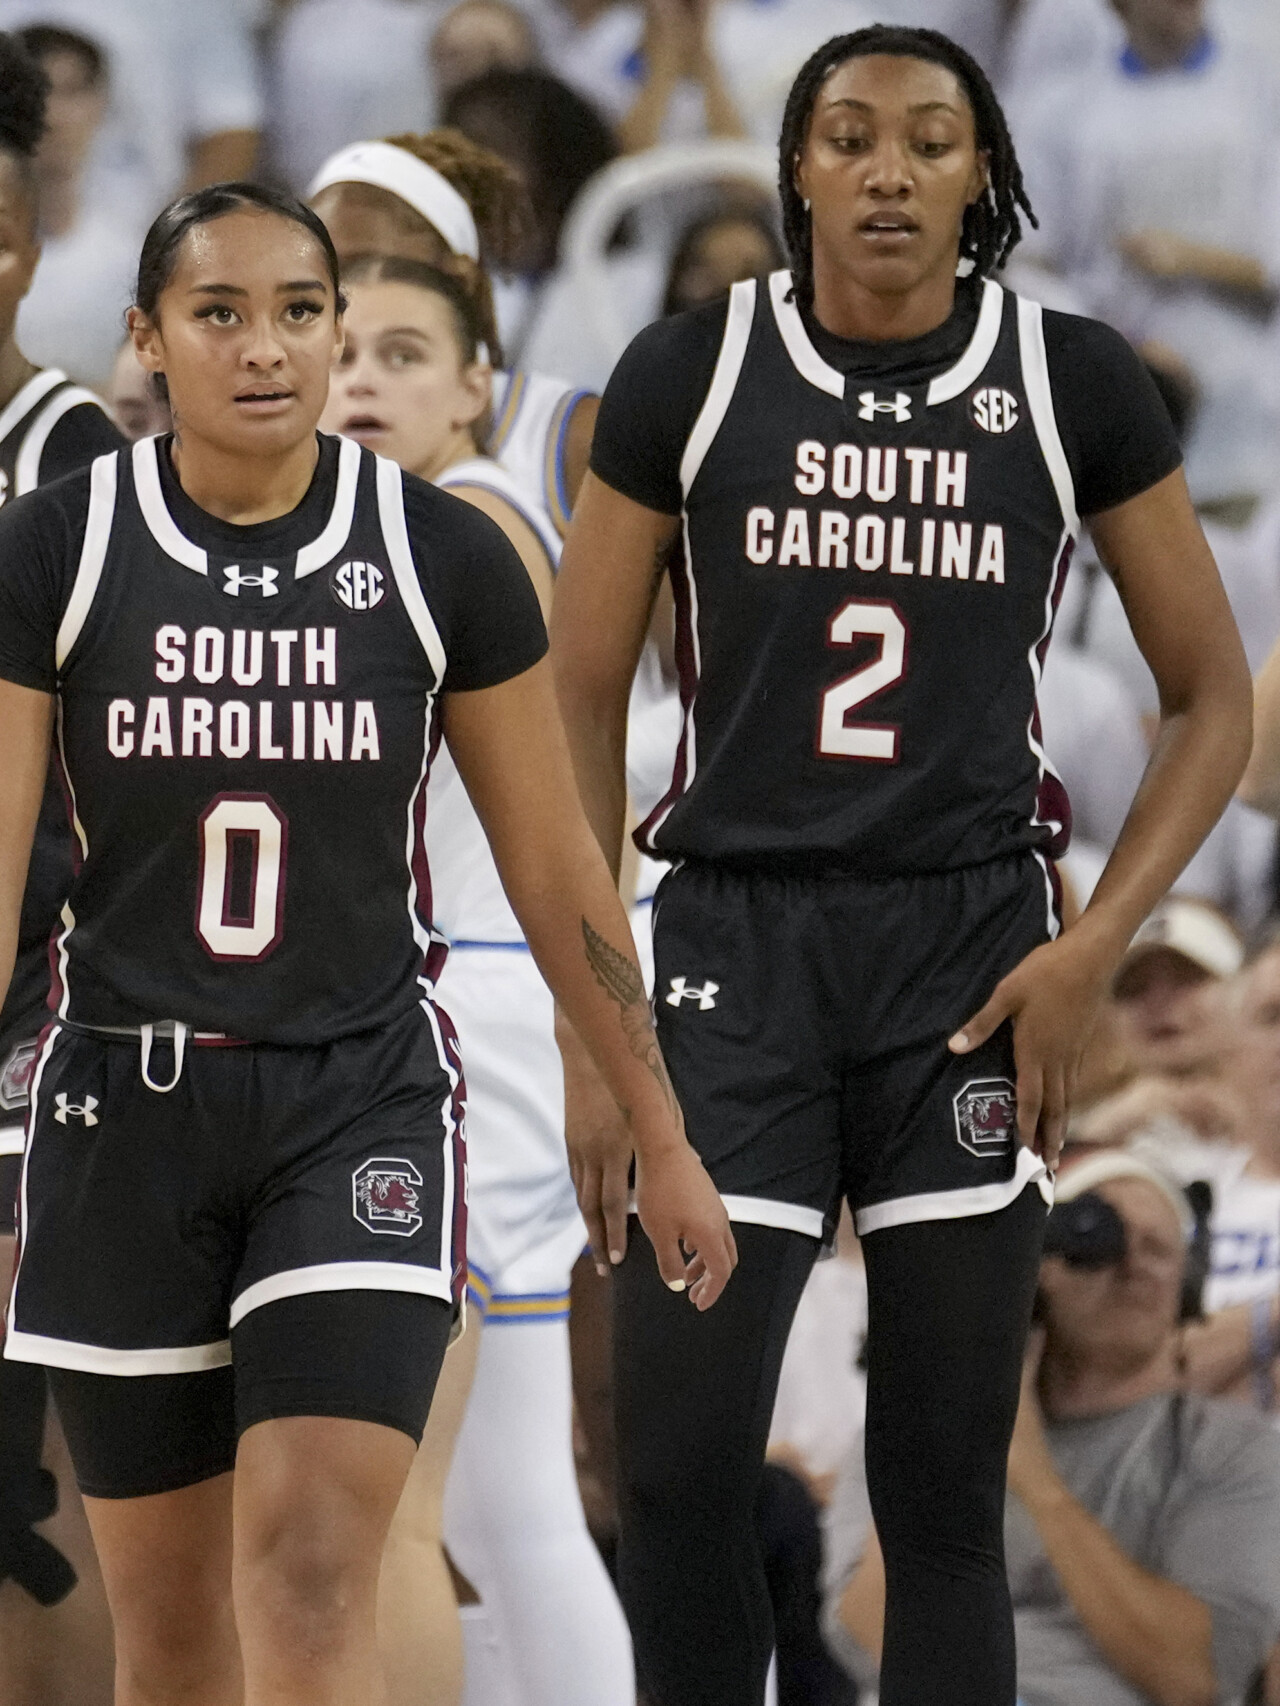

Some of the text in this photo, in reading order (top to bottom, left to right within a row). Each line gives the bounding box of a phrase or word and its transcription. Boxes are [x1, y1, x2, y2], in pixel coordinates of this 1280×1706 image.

[972, 388, 1019, 433] SEC
[795, 440, 968, 508] SOUTH
[745, 506, 1006, 584] CAROLINA
[335, 561, 385, 611] SEC
[154, 624, 337, 687] SOUTH
[815, 597, 910, 763] 2
[107, 697, 381, 761] CAROLINA
[195, 792, 289, 963] 0
